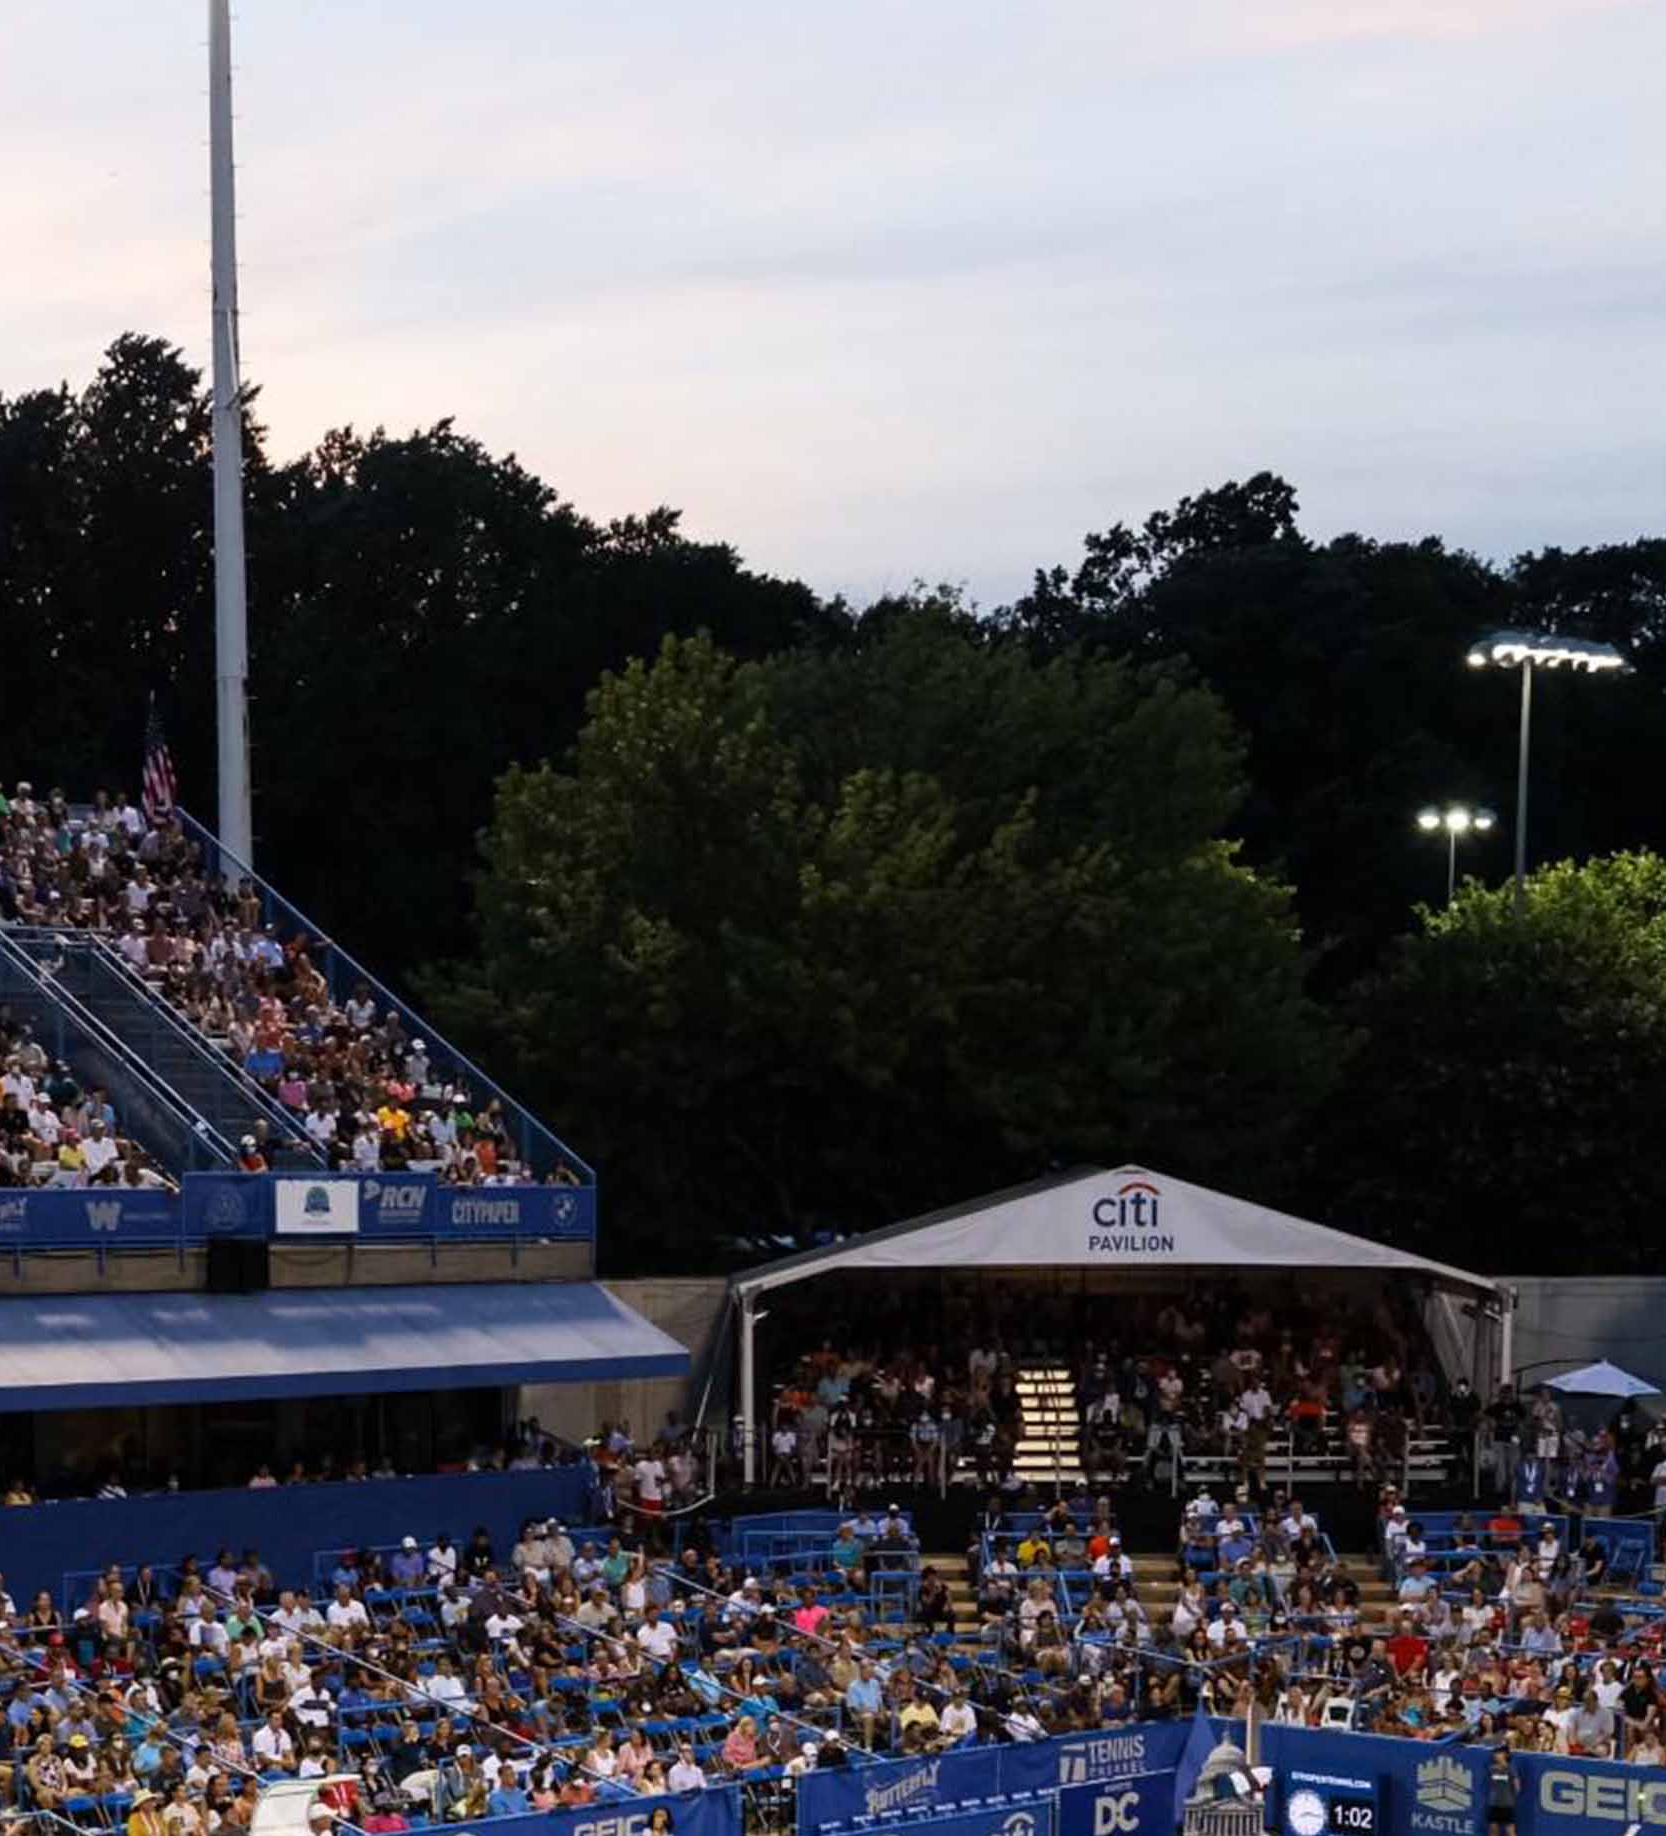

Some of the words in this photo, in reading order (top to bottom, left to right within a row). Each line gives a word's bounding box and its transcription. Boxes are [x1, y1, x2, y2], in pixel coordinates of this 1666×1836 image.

[1093, 1186, 1160, 1228] citi
[1088, 1235, 1174, 1252] PAVILION
[1088, 1734, 1145, 1765] TENNIS
[1334, 1805, 1373, 1829] 1:02
[1411, 1811, 1476, 1835] KASTLE
